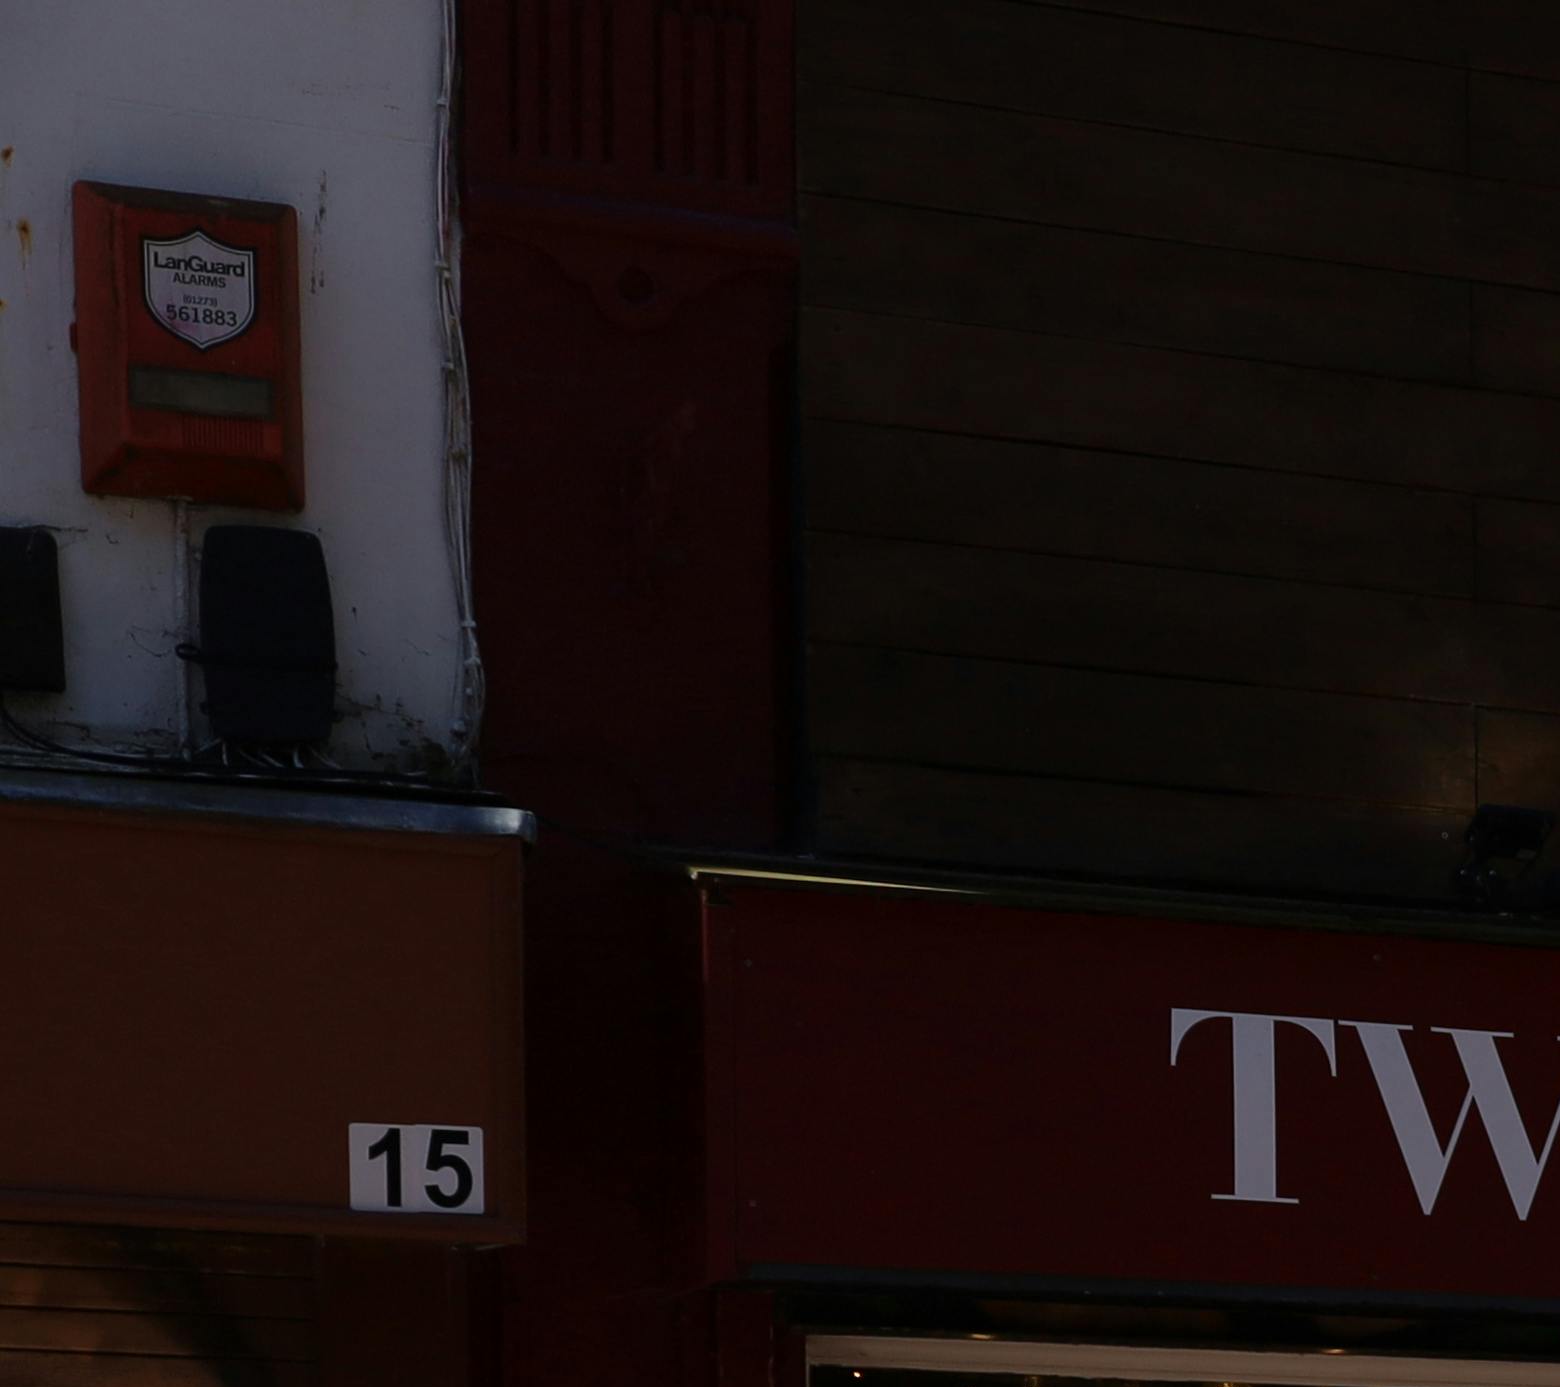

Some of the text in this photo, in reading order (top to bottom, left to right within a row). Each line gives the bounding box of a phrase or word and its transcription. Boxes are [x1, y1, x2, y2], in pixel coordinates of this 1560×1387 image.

[154, 251, 245, 277] LanGuard
[173, 272, 226, 288] ALARMS
[166, 304, 237, 327] 561883
[368, 1127, 473, 1209] 15
